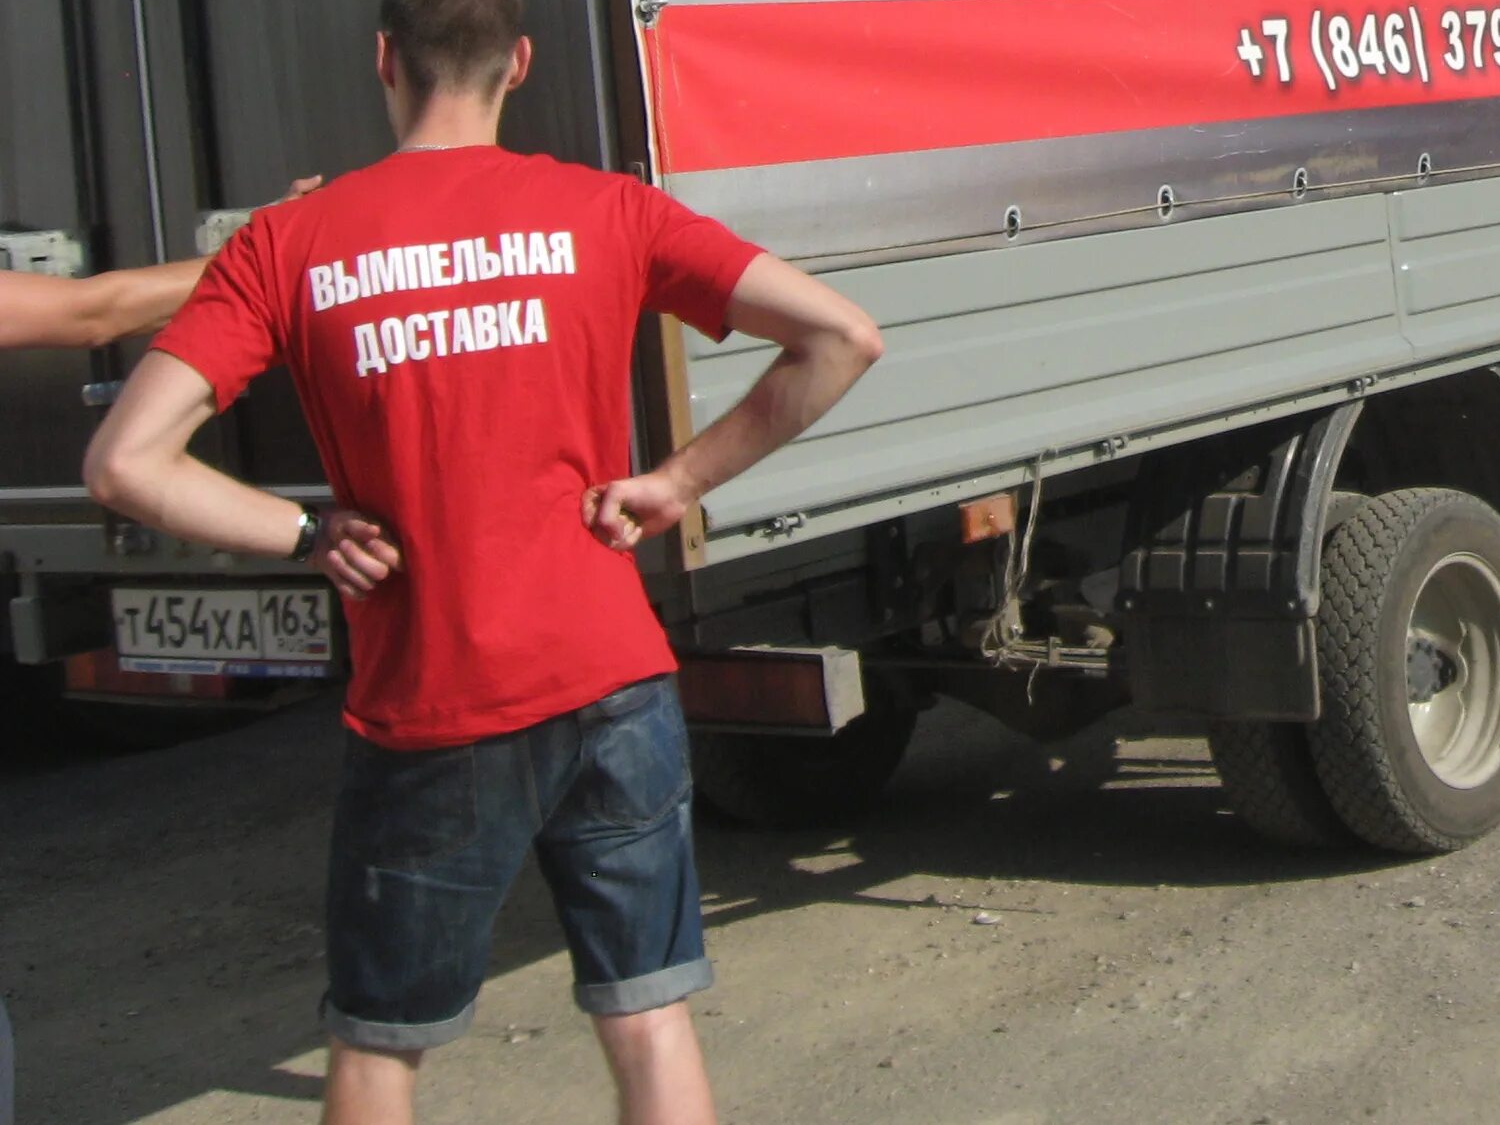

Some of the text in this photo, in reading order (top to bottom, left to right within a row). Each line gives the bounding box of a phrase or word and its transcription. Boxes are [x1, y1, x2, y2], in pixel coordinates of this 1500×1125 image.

[1237, 18, 1290, 83] +7
[1311, 6, 1429, 91] (846)
[308, 231, 576, 312] ВЫМПЕЛЬНАЯ
[353, 298, 548, 378] ДОСТАВКА
[263, 594, 321, 637] 163
